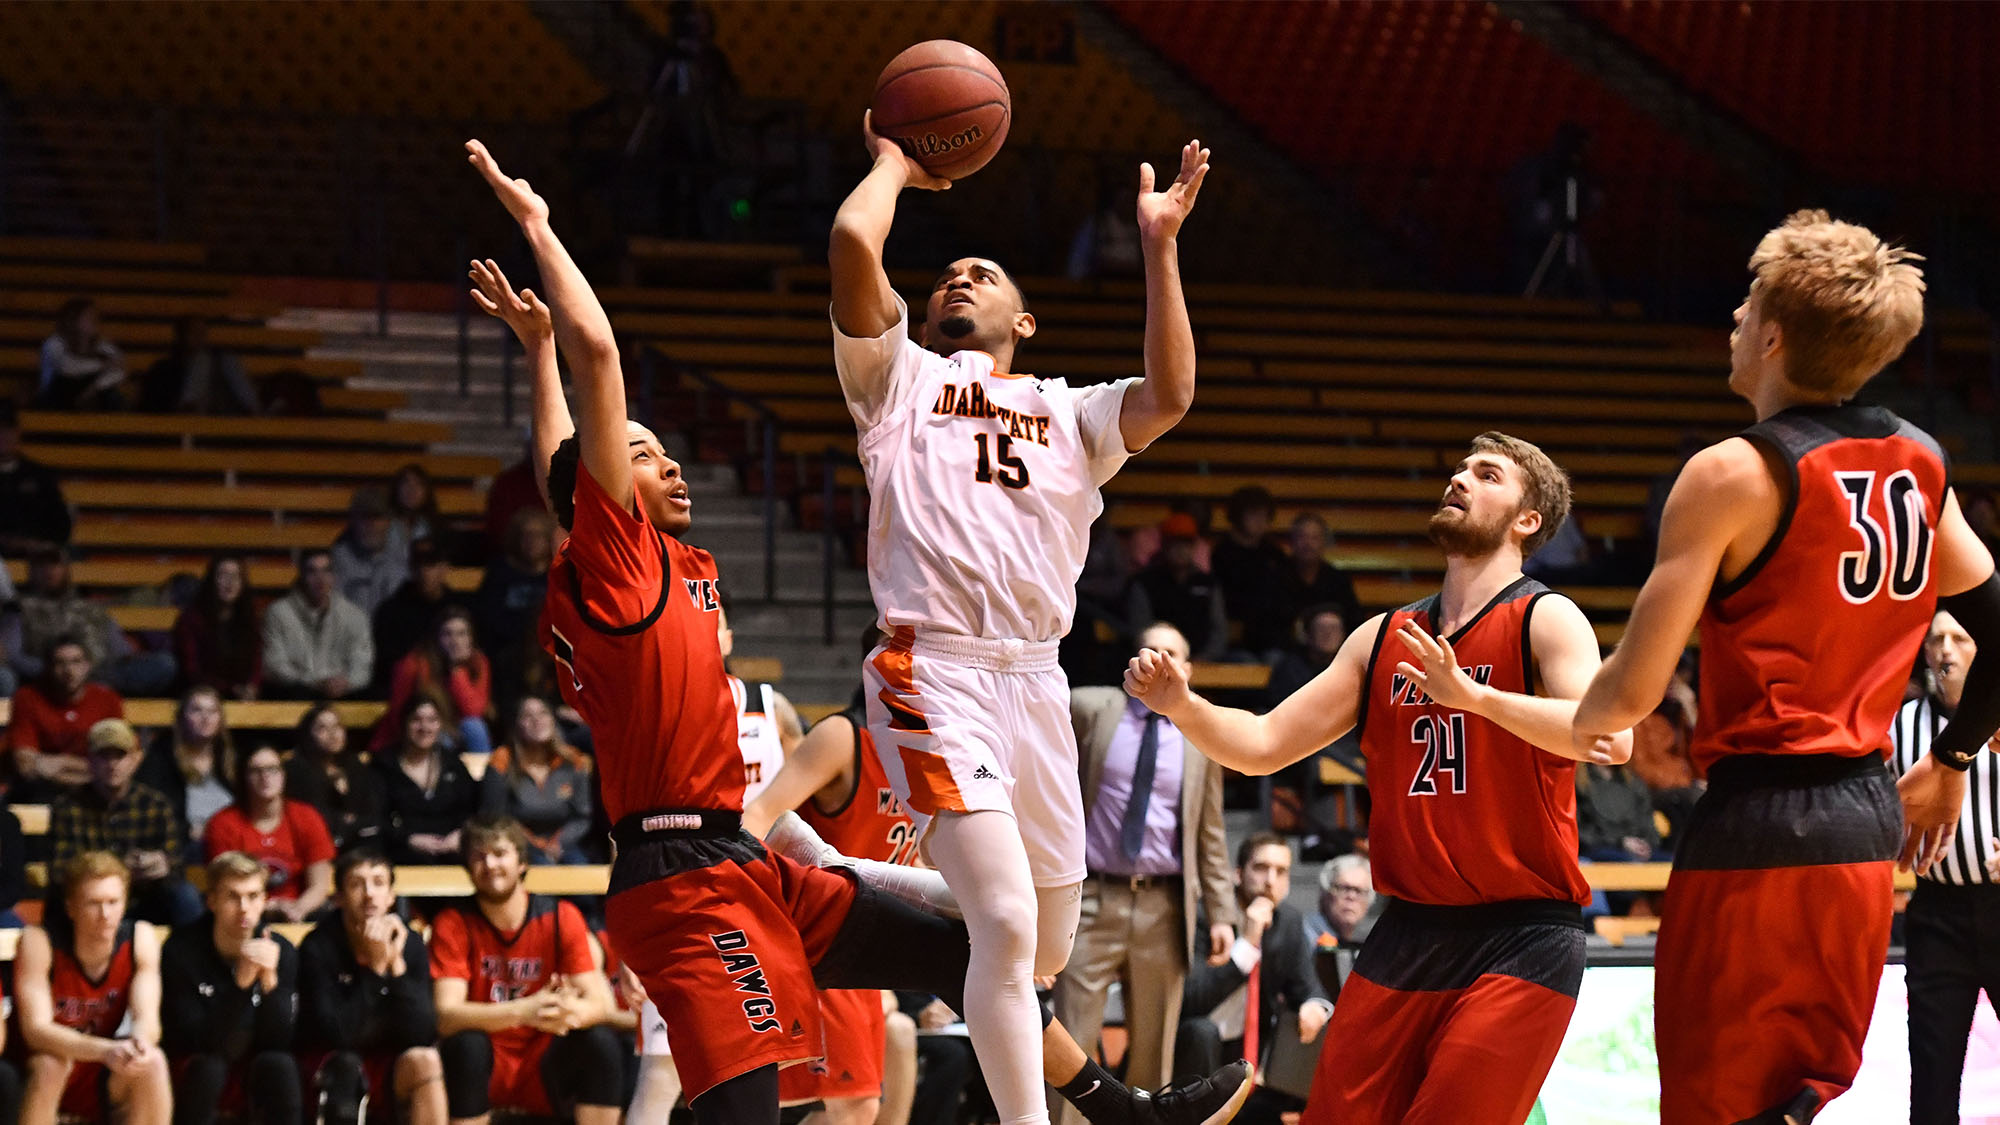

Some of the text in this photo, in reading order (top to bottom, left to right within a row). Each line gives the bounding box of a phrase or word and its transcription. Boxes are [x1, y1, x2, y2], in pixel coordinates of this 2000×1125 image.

[974, 432, 1030, 490] 15
[997, 405, 1050, 449] TATE
[1833, 469, 1935, 605] 30
[682, 577, 720, 612] WE
[1407, 712, 1467, 796] 24
[708, 929, 783, 1033] DAWGS
